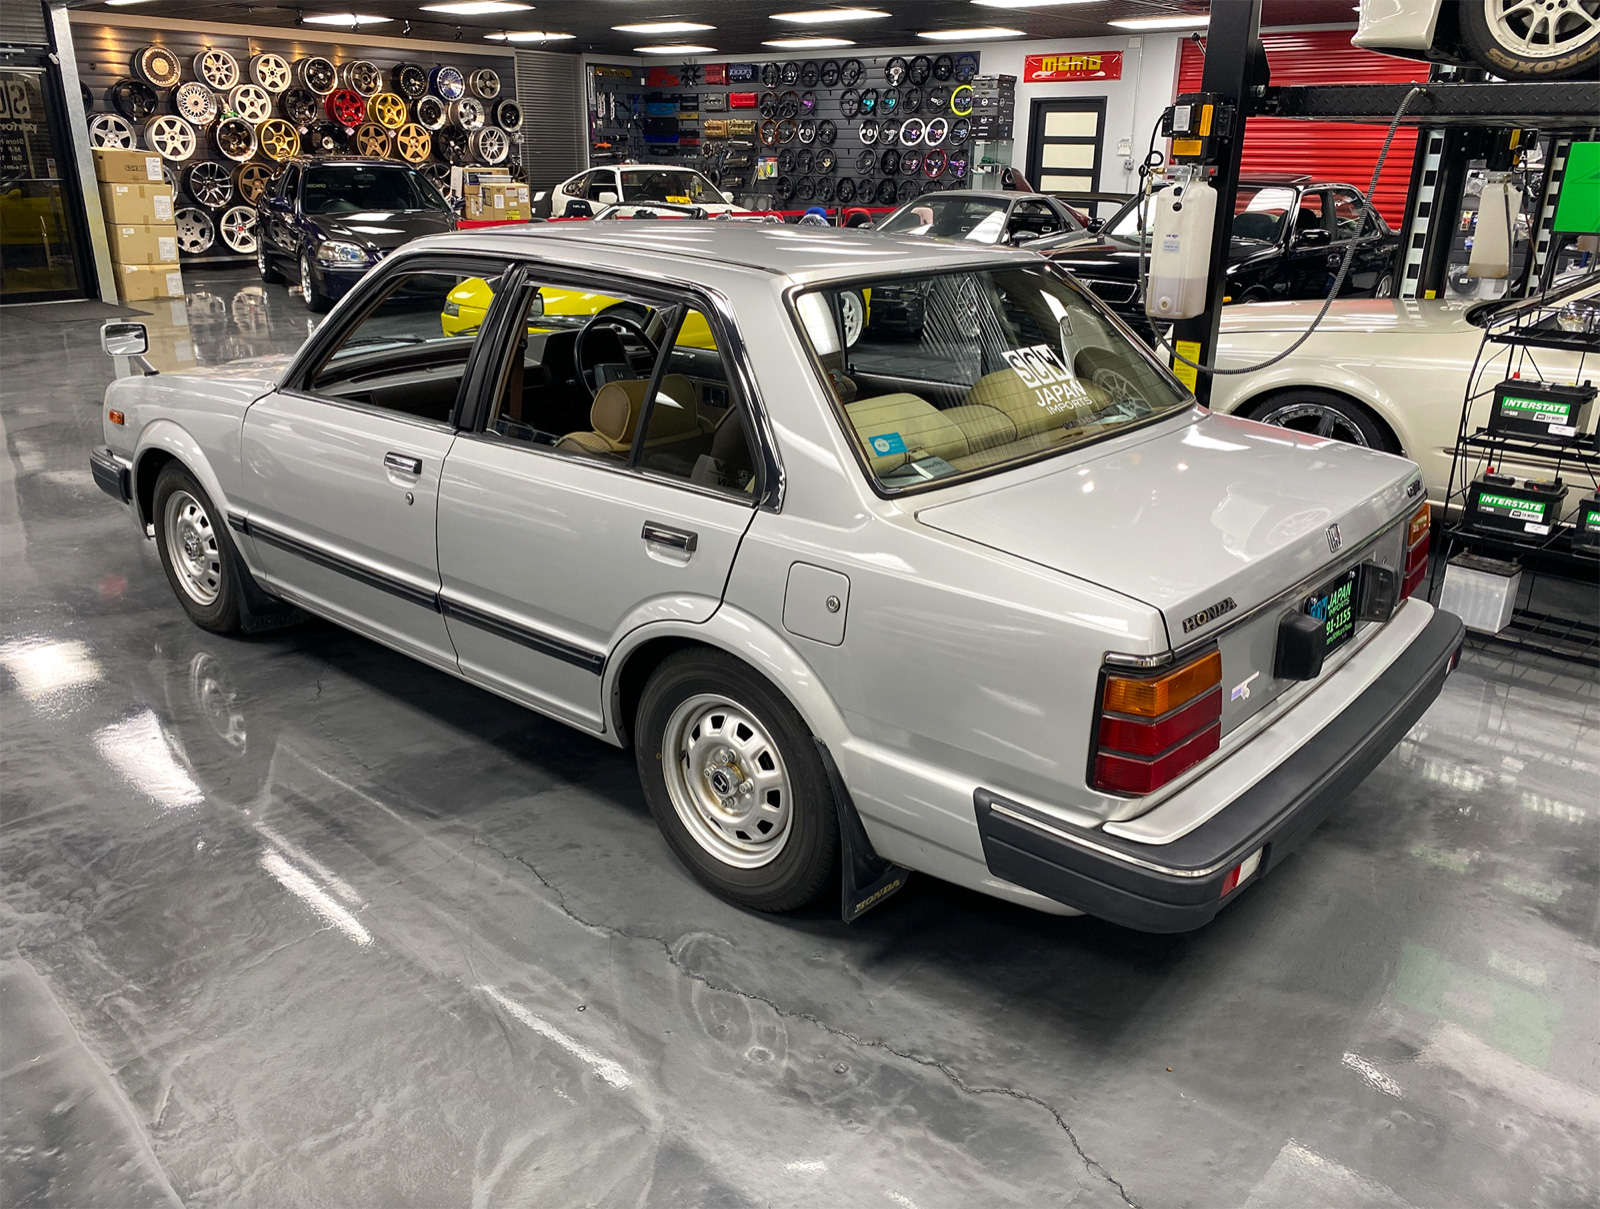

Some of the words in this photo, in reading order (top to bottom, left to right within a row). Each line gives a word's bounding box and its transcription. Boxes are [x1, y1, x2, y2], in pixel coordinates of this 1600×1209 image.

[1485, 40, 1600, 74] PROXES
[1003, 345, 1071, 387] SCW
[1035, 379, 1087, 407] JAPAN
[1046, 396, 1093, 415] IMPORTS
[1504, 399, 1568, 414] INTERSTATE
[1481, 495, 1542, 511] INTERSTATE
[1328, 580, 1353, 610] JAPAN
[1182, 596, 1237, 634] HONDA
[855, 879, 900, 913] HONDA
